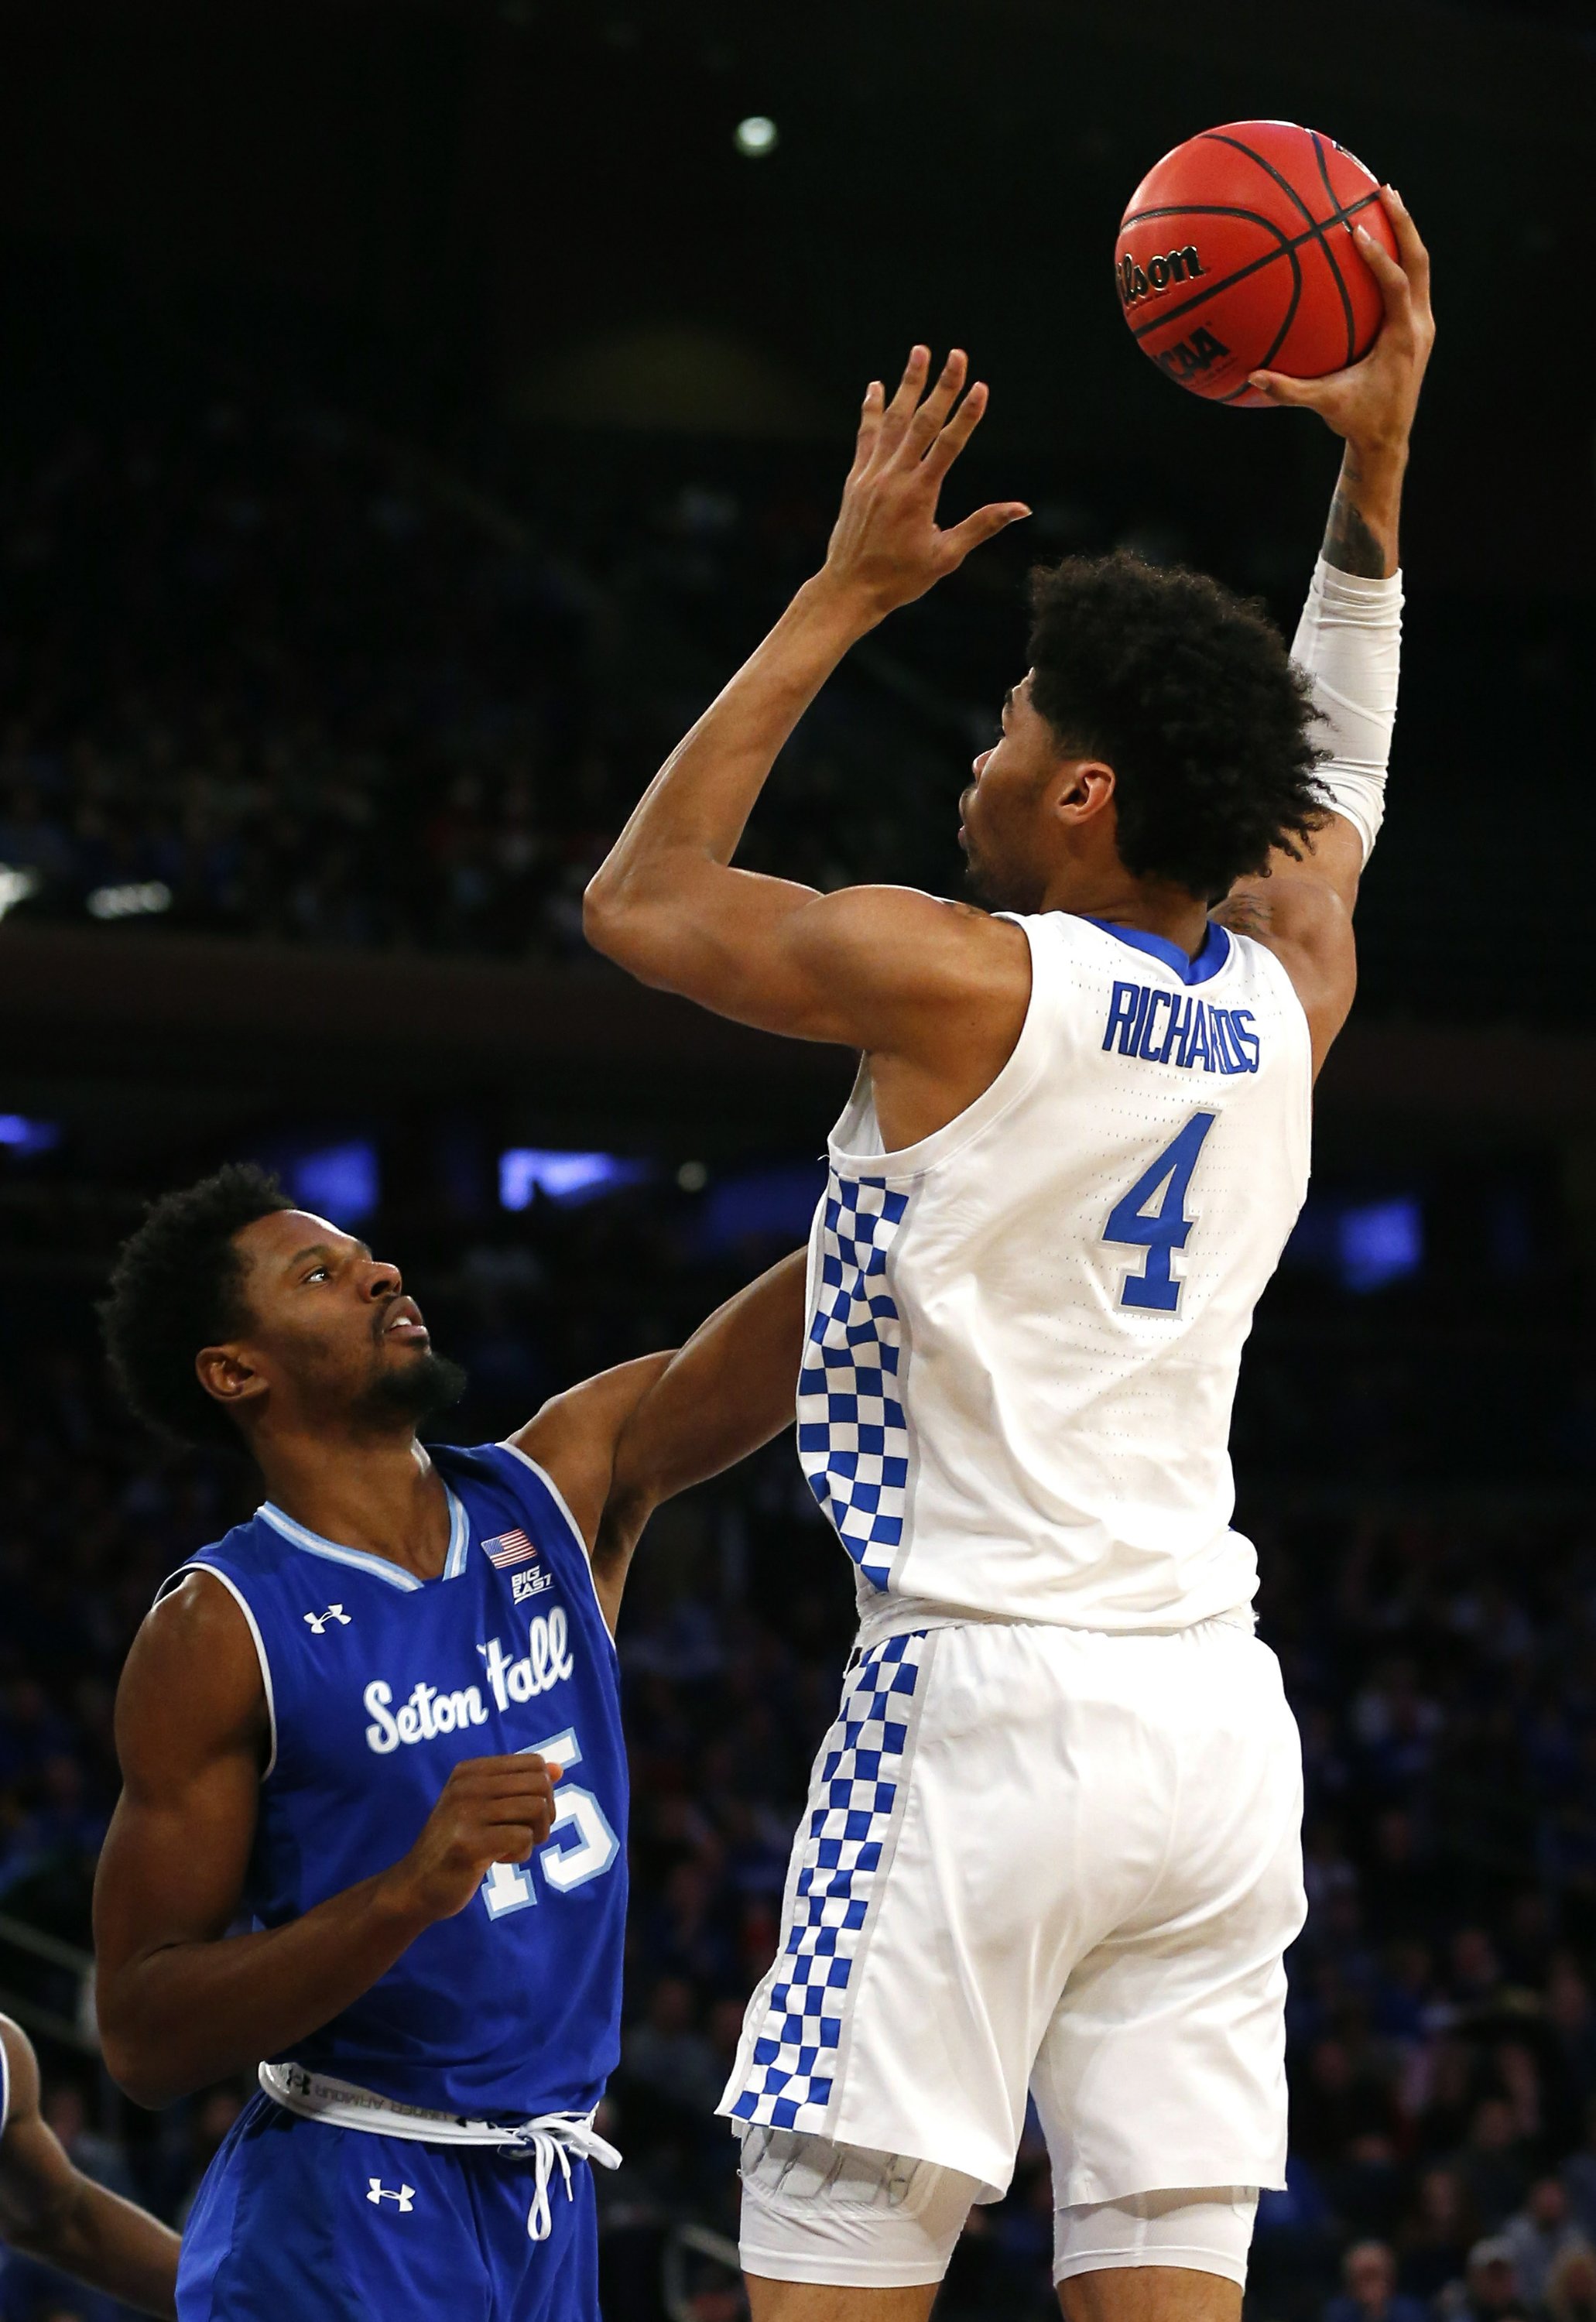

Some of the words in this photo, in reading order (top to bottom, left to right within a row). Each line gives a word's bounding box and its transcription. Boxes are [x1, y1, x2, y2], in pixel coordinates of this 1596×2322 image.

[1117, 245, 1205, 308] ilson
[1155, 326, 1232, 380] CAA
[1101, 981, 1260, 1075] RICHARDS
[1096, 1105, 1223, 1320] 4
[511, 1565, 540, 1587] BIG
[512, 1572, 551, 1599] EAST
[363, 1680, 489, 1755] Seton
